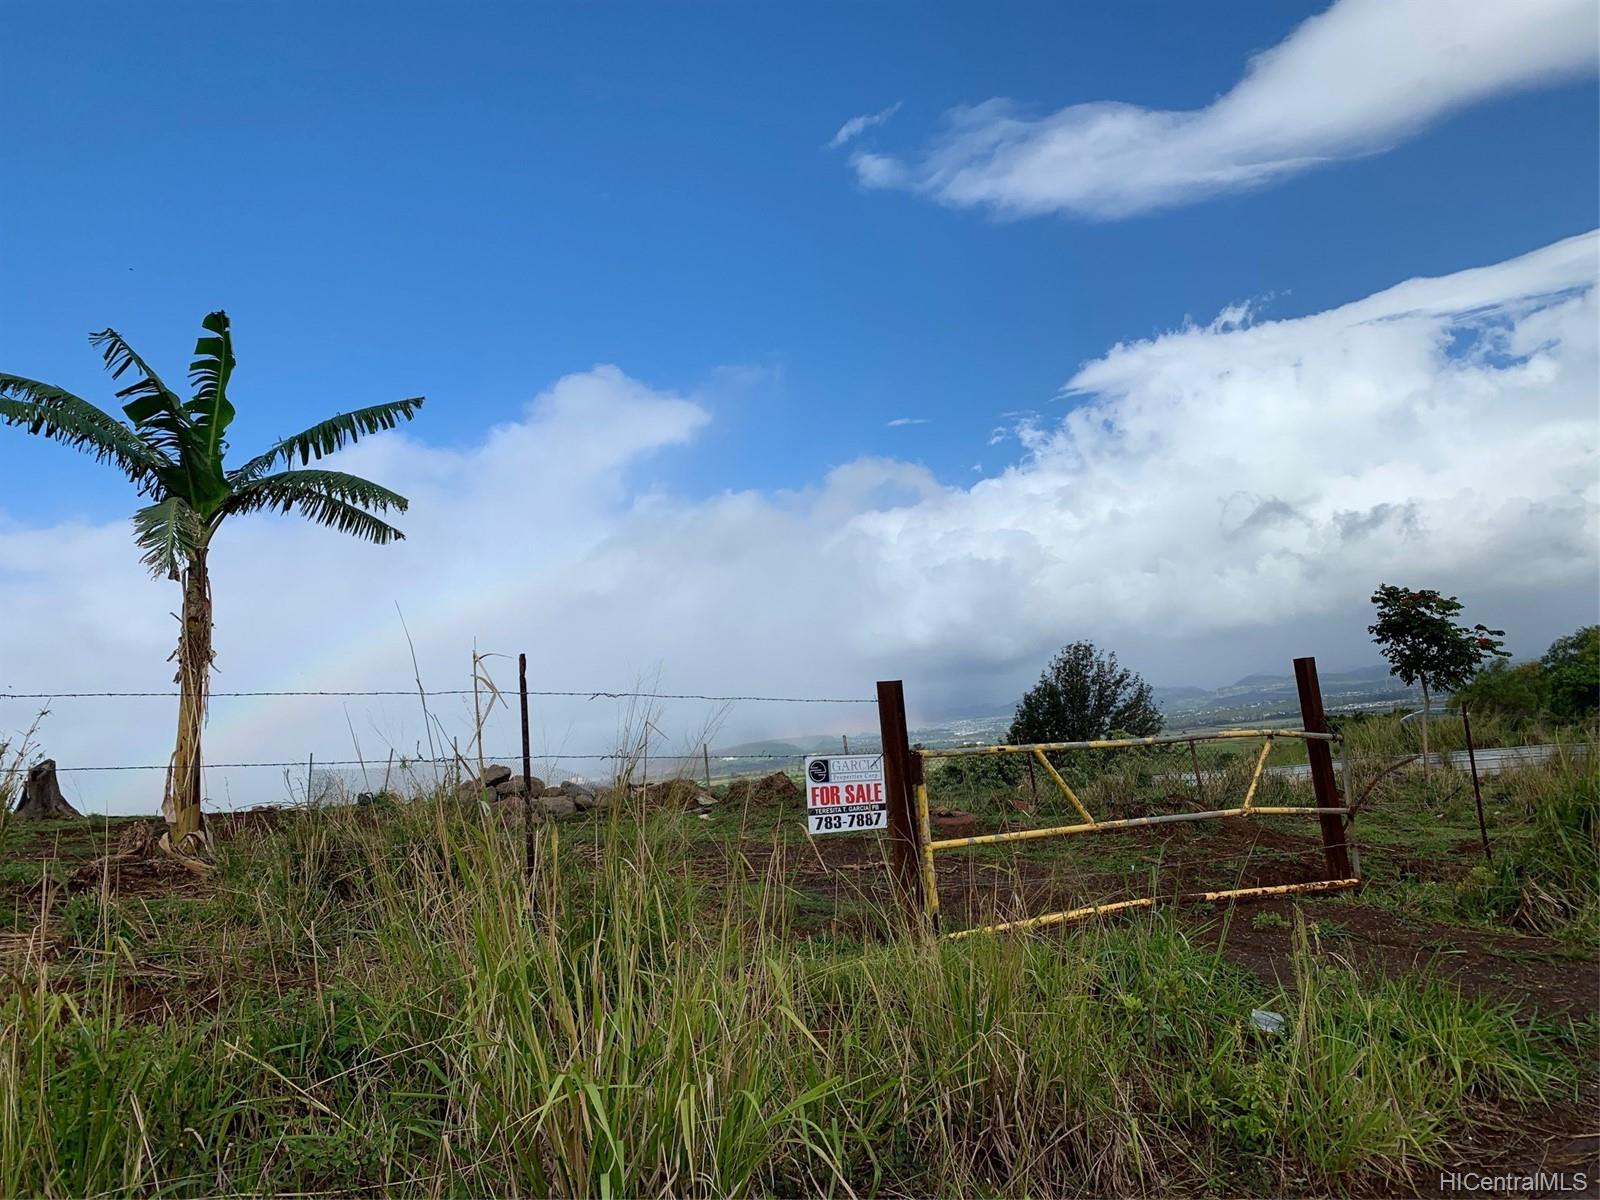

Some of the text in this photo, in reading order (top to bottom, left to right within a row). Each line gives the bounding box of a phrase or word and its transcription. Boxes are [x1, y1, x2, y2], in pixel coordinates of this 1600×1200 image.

[832, 759, 879, 771] GARCIA
[811, 783, 882, 806] FOR SALE
[815, 813, 882, 831] 783-7887
